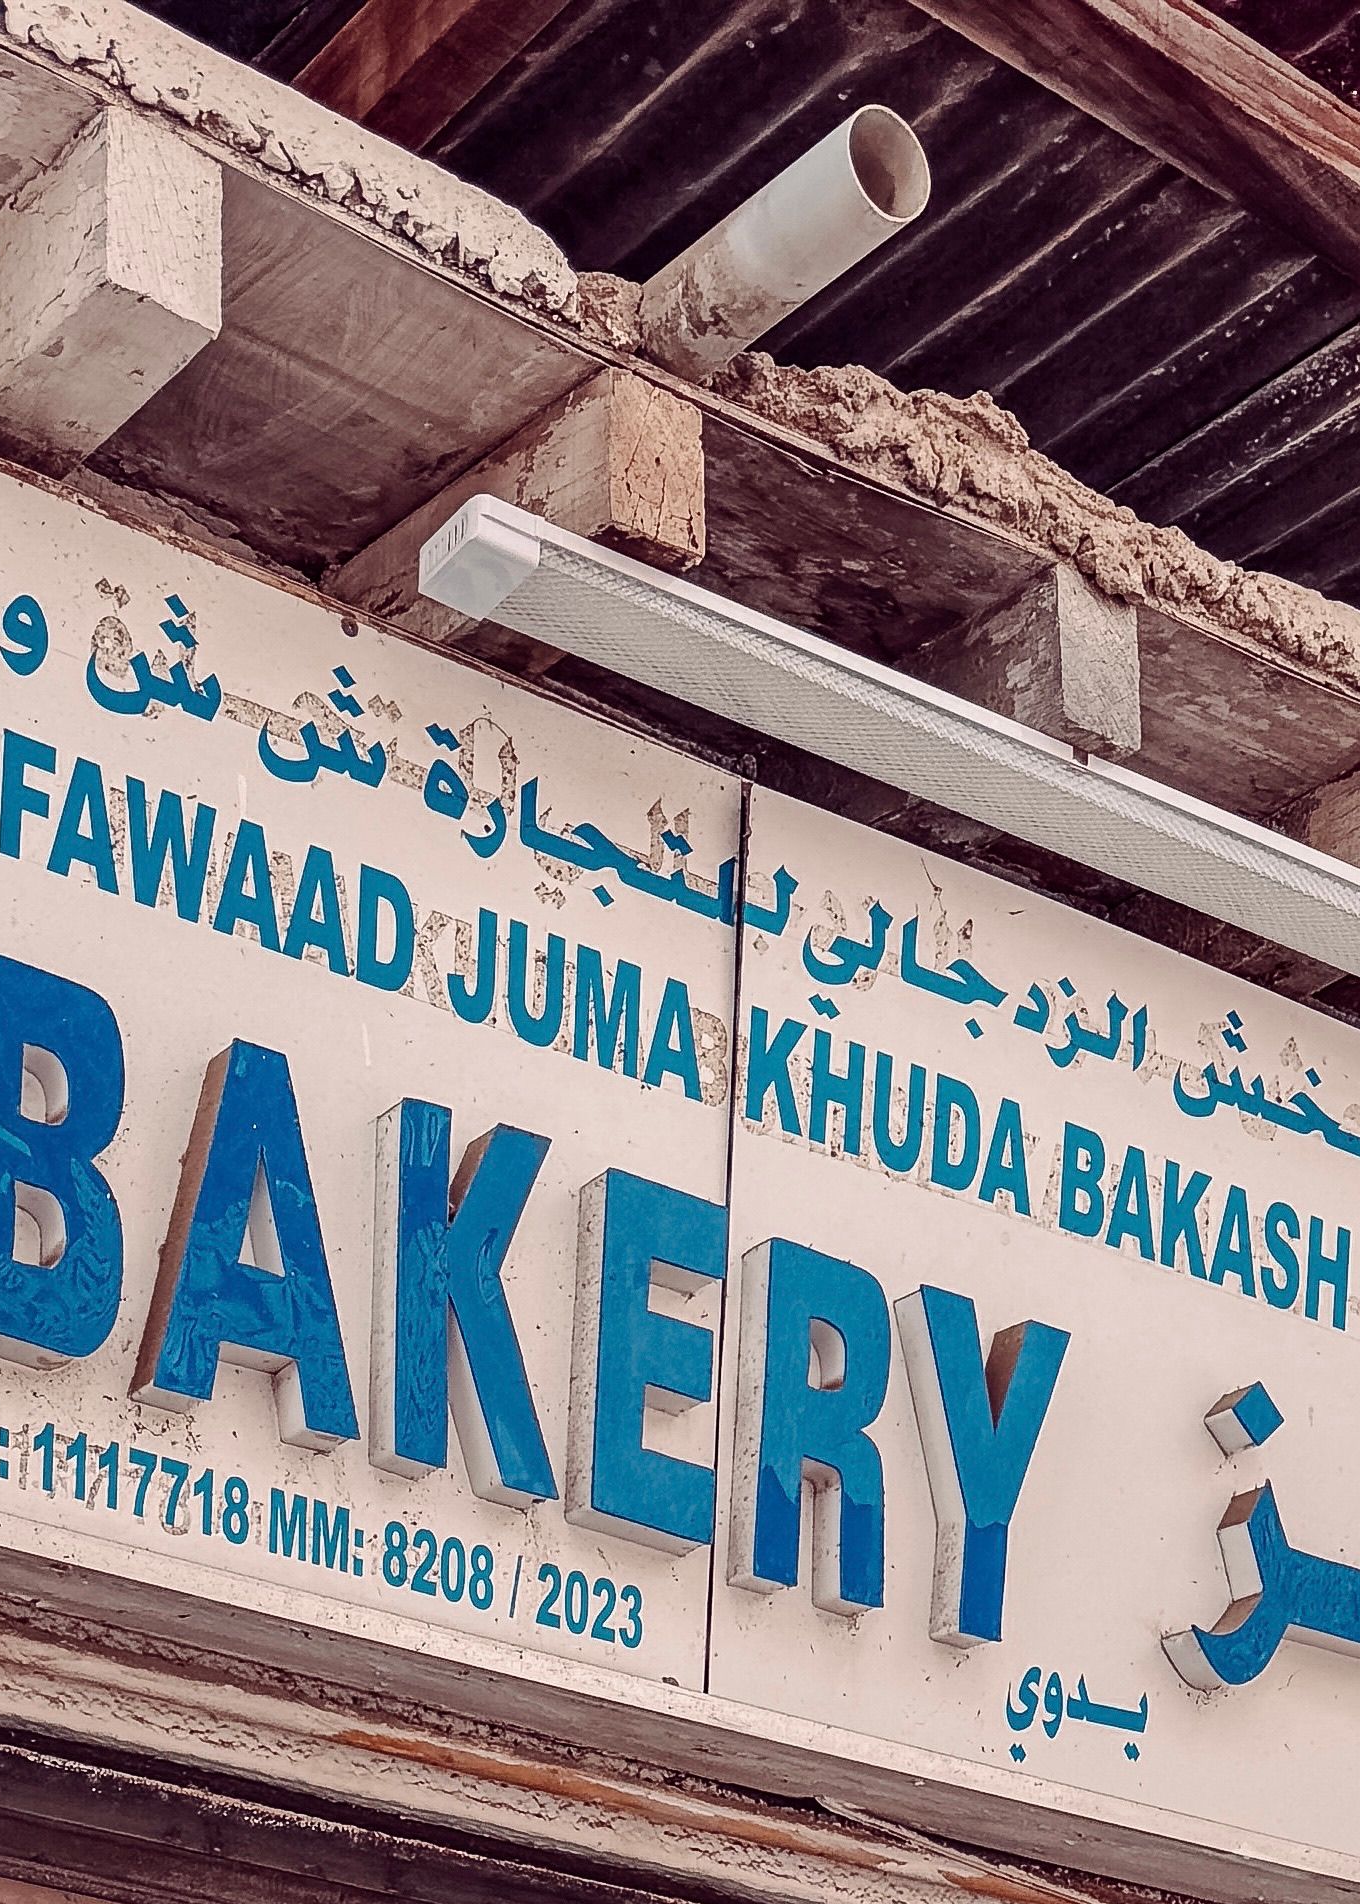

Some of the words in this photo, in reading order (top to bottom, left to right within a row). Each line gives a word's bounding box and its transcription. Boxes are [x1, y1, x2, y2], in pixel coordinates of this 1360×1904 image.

[86, 594, 222, 722] ش
[257, 665, 388, 789] ش
[447, 908, 704, 1102] JUMA
[743, 1005, 1032, 1219] KHUDA
[1058, 1121, 1351, 1332] BAKASH
[32, 1421, 251, 1547] 1117718
[268, 1488, 365, 1578] MM:
[383, 1521, 495, 1611] 8208
[536, 1562, 644, 1651] 2023
